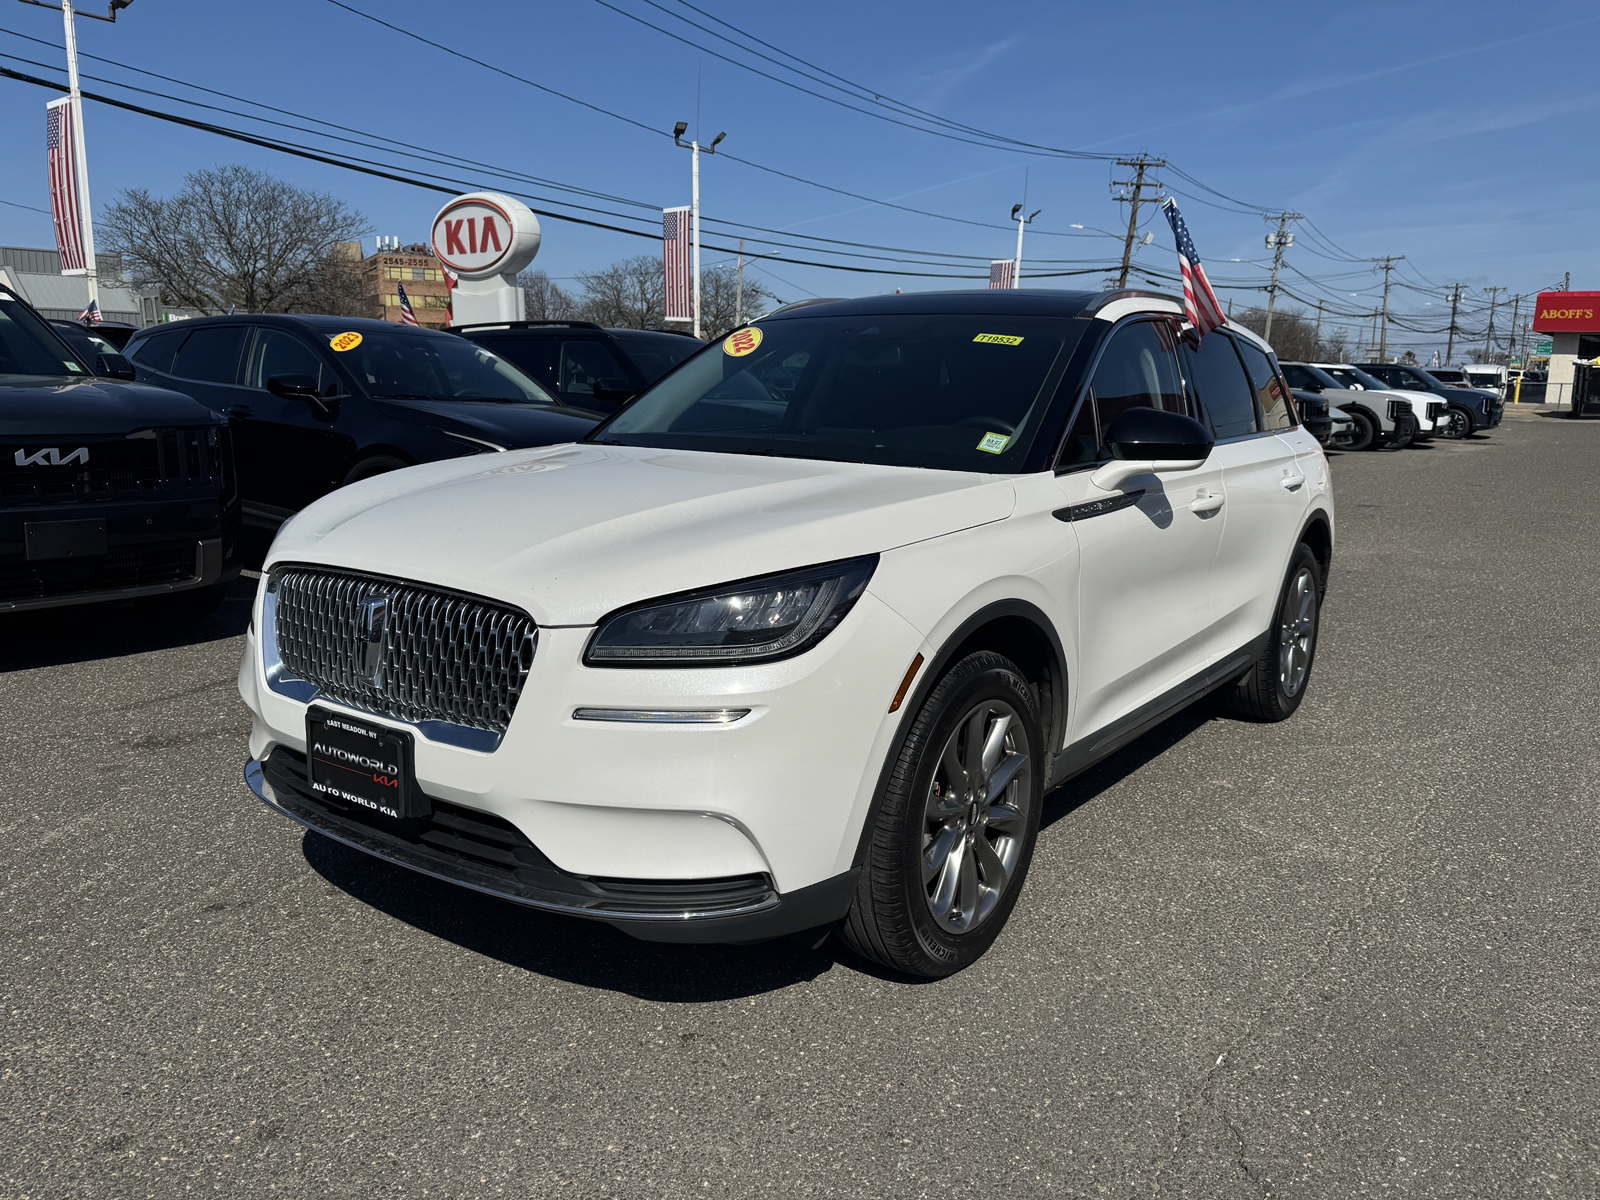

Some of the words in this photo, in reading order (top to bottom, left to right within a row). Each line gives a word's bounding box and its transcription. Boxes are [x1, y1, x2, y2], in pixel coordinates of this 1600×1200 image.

[444, 215, 502, 256] KIA
[383, 258, 429, 267] 2545-2555
[1540, 309, 1593, 319] ABOFF'S
[334, 333, 359, 350] 2023
[731, 330, 756, 354] 2022
[14, 447, 89, 466] KIA
[326, 719, 341, 730] EAST
[368, 730, 377, 739] NY
[313, 742, 398, 775] AUTOWORLD
[374, 773, 398, 788] KIA
[312, 783, 339, 796] AUTO
[341, 792, 377, 810] WORLD
[379, 806, 398, 818] KIA
